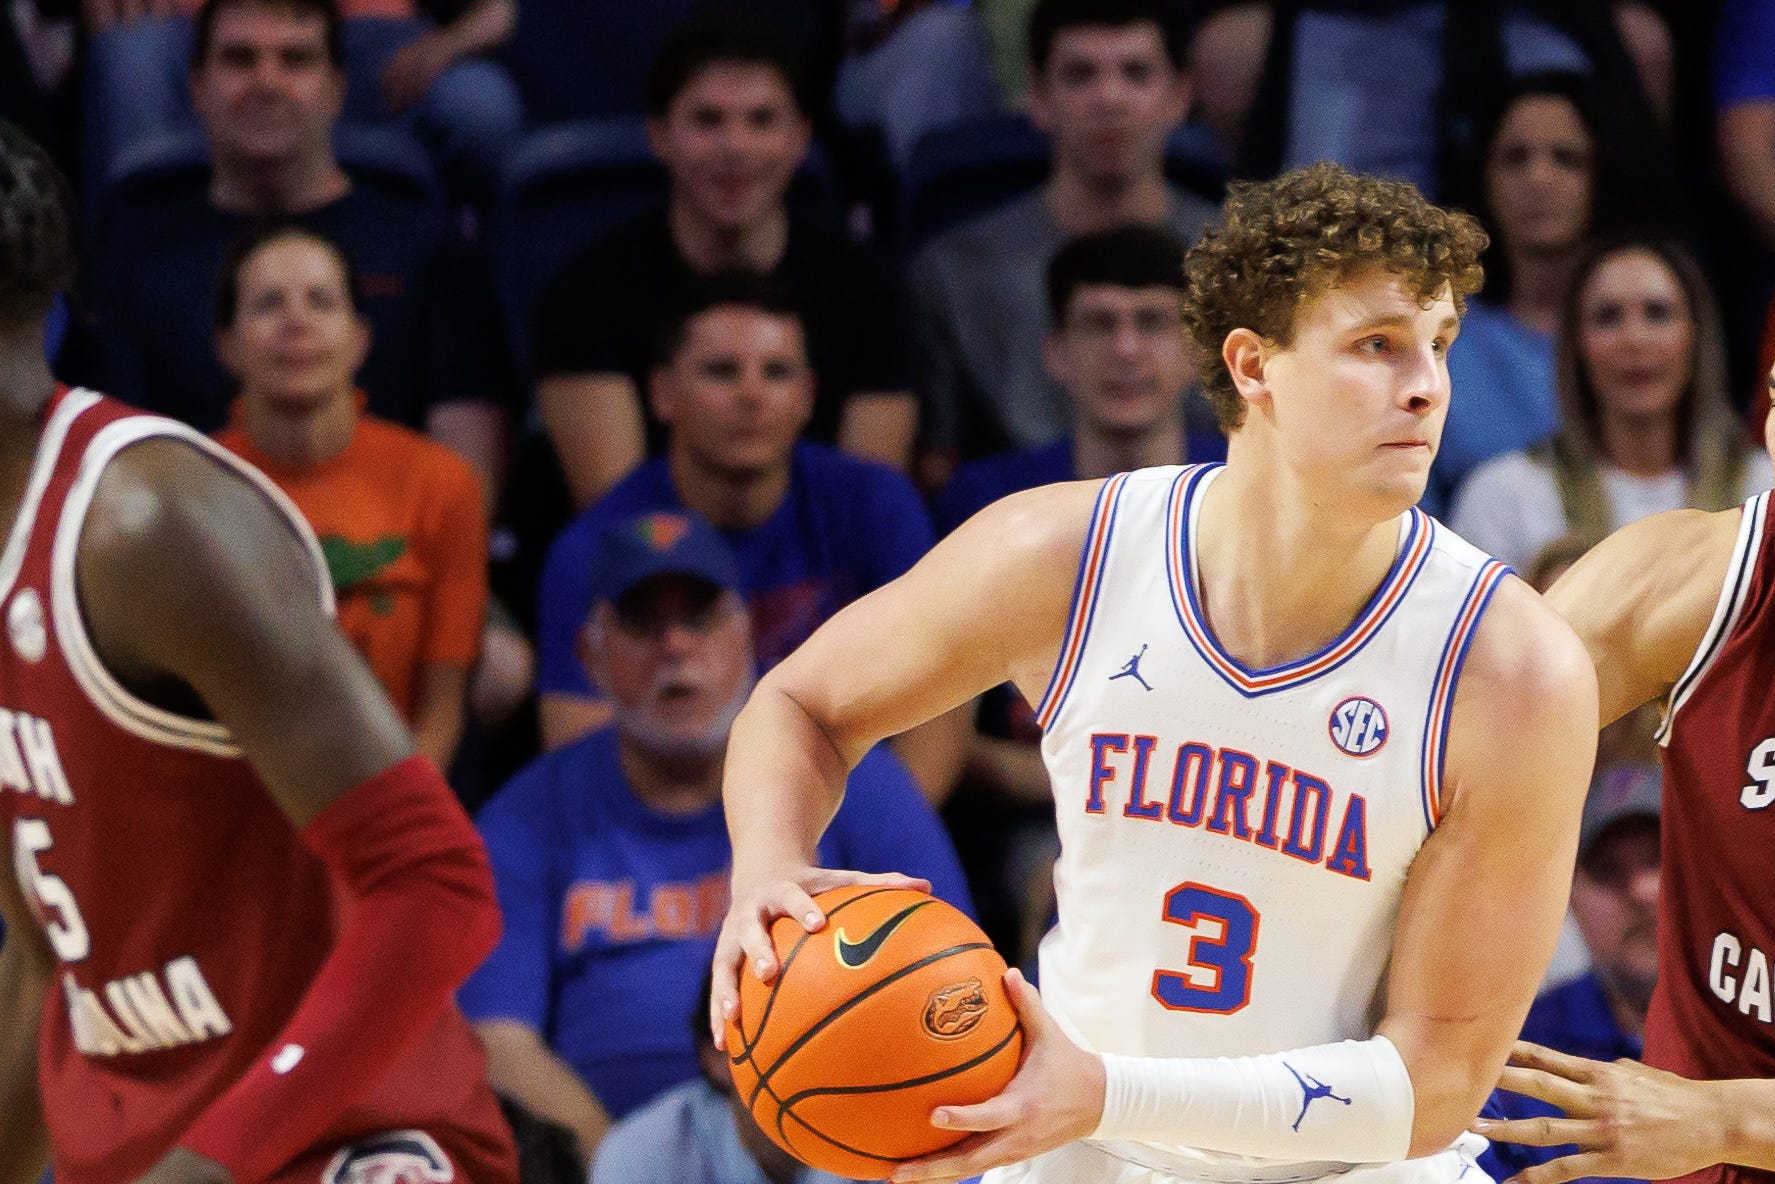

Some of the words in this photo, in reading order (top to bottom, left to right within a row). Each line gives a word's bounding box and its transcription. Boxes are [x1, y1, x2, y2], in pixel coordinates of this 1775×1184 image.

[1331, 698, 1388, 755] SEC
[1085, 732, 1373, 882] FLORIDA
[14, 818, 91, 962] 5
[1151, 881, 1261, 1016] 3
